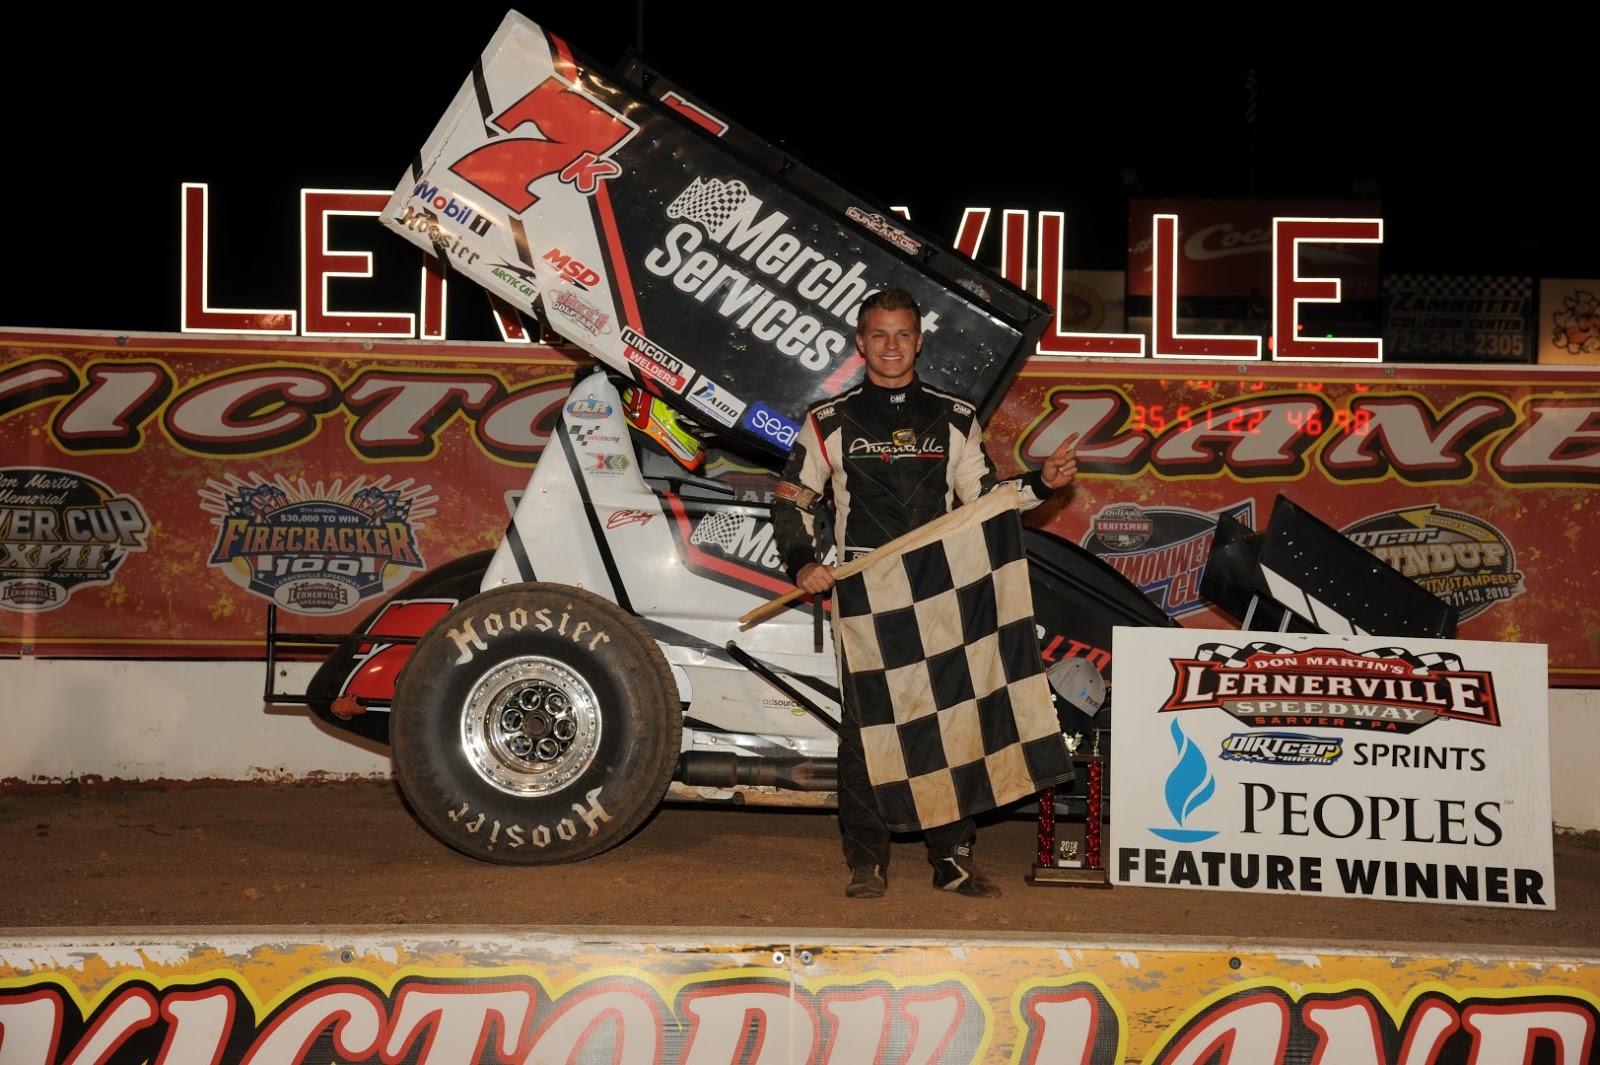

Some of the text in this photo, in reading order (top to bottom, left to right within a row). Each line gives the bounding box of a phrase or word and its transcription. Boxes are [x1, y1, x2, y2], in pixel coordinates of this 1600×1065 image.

[449, 74, 638, 215] 7
[561, 154, 620, 192] K
[415, 180, 472, 225] Mobil
[395, 206, 480, 265] Hoosier
[848, 209, 898, 242] DUNCAN
[900, 239, 918, 254] OIL
[180, 182, 1384, 363] LEILLE
[541, 248, 600, 287] MSD
[711, 195, 940, 334] Merchat
[491, 267, 536, 298] ARCTIC CAT
[644, 223, 846, 372] Services
[552, 302, 576, 317] GOLF
[1391, 292, 1524, 313] ZAMBOTTI
[1390, 317, 1523, 331] COLLISION CENTER
[623, 328, 681, 377] LINCOLN
[1390, 331, 1525, 356] 724-545-2305
[629, 350, 678, 388] WELDERS
[817, 407, 836, 420] OMP
[890, 393, 906, 403] OMP
[953, 403, 972, 416] OMP
[1228, 408, 1264, 434] 22
[24, 473, 79, 489] Martin
[65, 498, 145, 547] CUP
[280, 514, 359, 523] $30,000 TO WIN
[1097, 522, 1149, 531] CRAFTSMAN
[216, 518, 418, 564] FIRECRACKER
[275, 558, 360, 577] 100
[275, 572, 361, 588] LERNERVILLE SPEEDWAY
[290, 588, 346, 604] LERNERVILLE
[1453, 589, 1485, 606] 11-13,
[1485, 586, 1510, 599] 2018
[446, 603, 610, 666] Hoosier
[1255, 656, 1406, 675] DON MARTIN'S
[1181, 665, 1486, 716] LERNERVILLE
[1236, 701, 1424, 721] SPEEDWAY
[1254, 716, 1397, 731] SARVER PA
[1227, 736, 1486, 772] DIRTcar SPRINTS
[448, 786, 615, 851] Hoosier
[1239, 782, 1503, 847] PEOPLES
[1060, 840, 1078, 852] 2018
[1118, 847, 1547, 906] FEATURE WINNER
